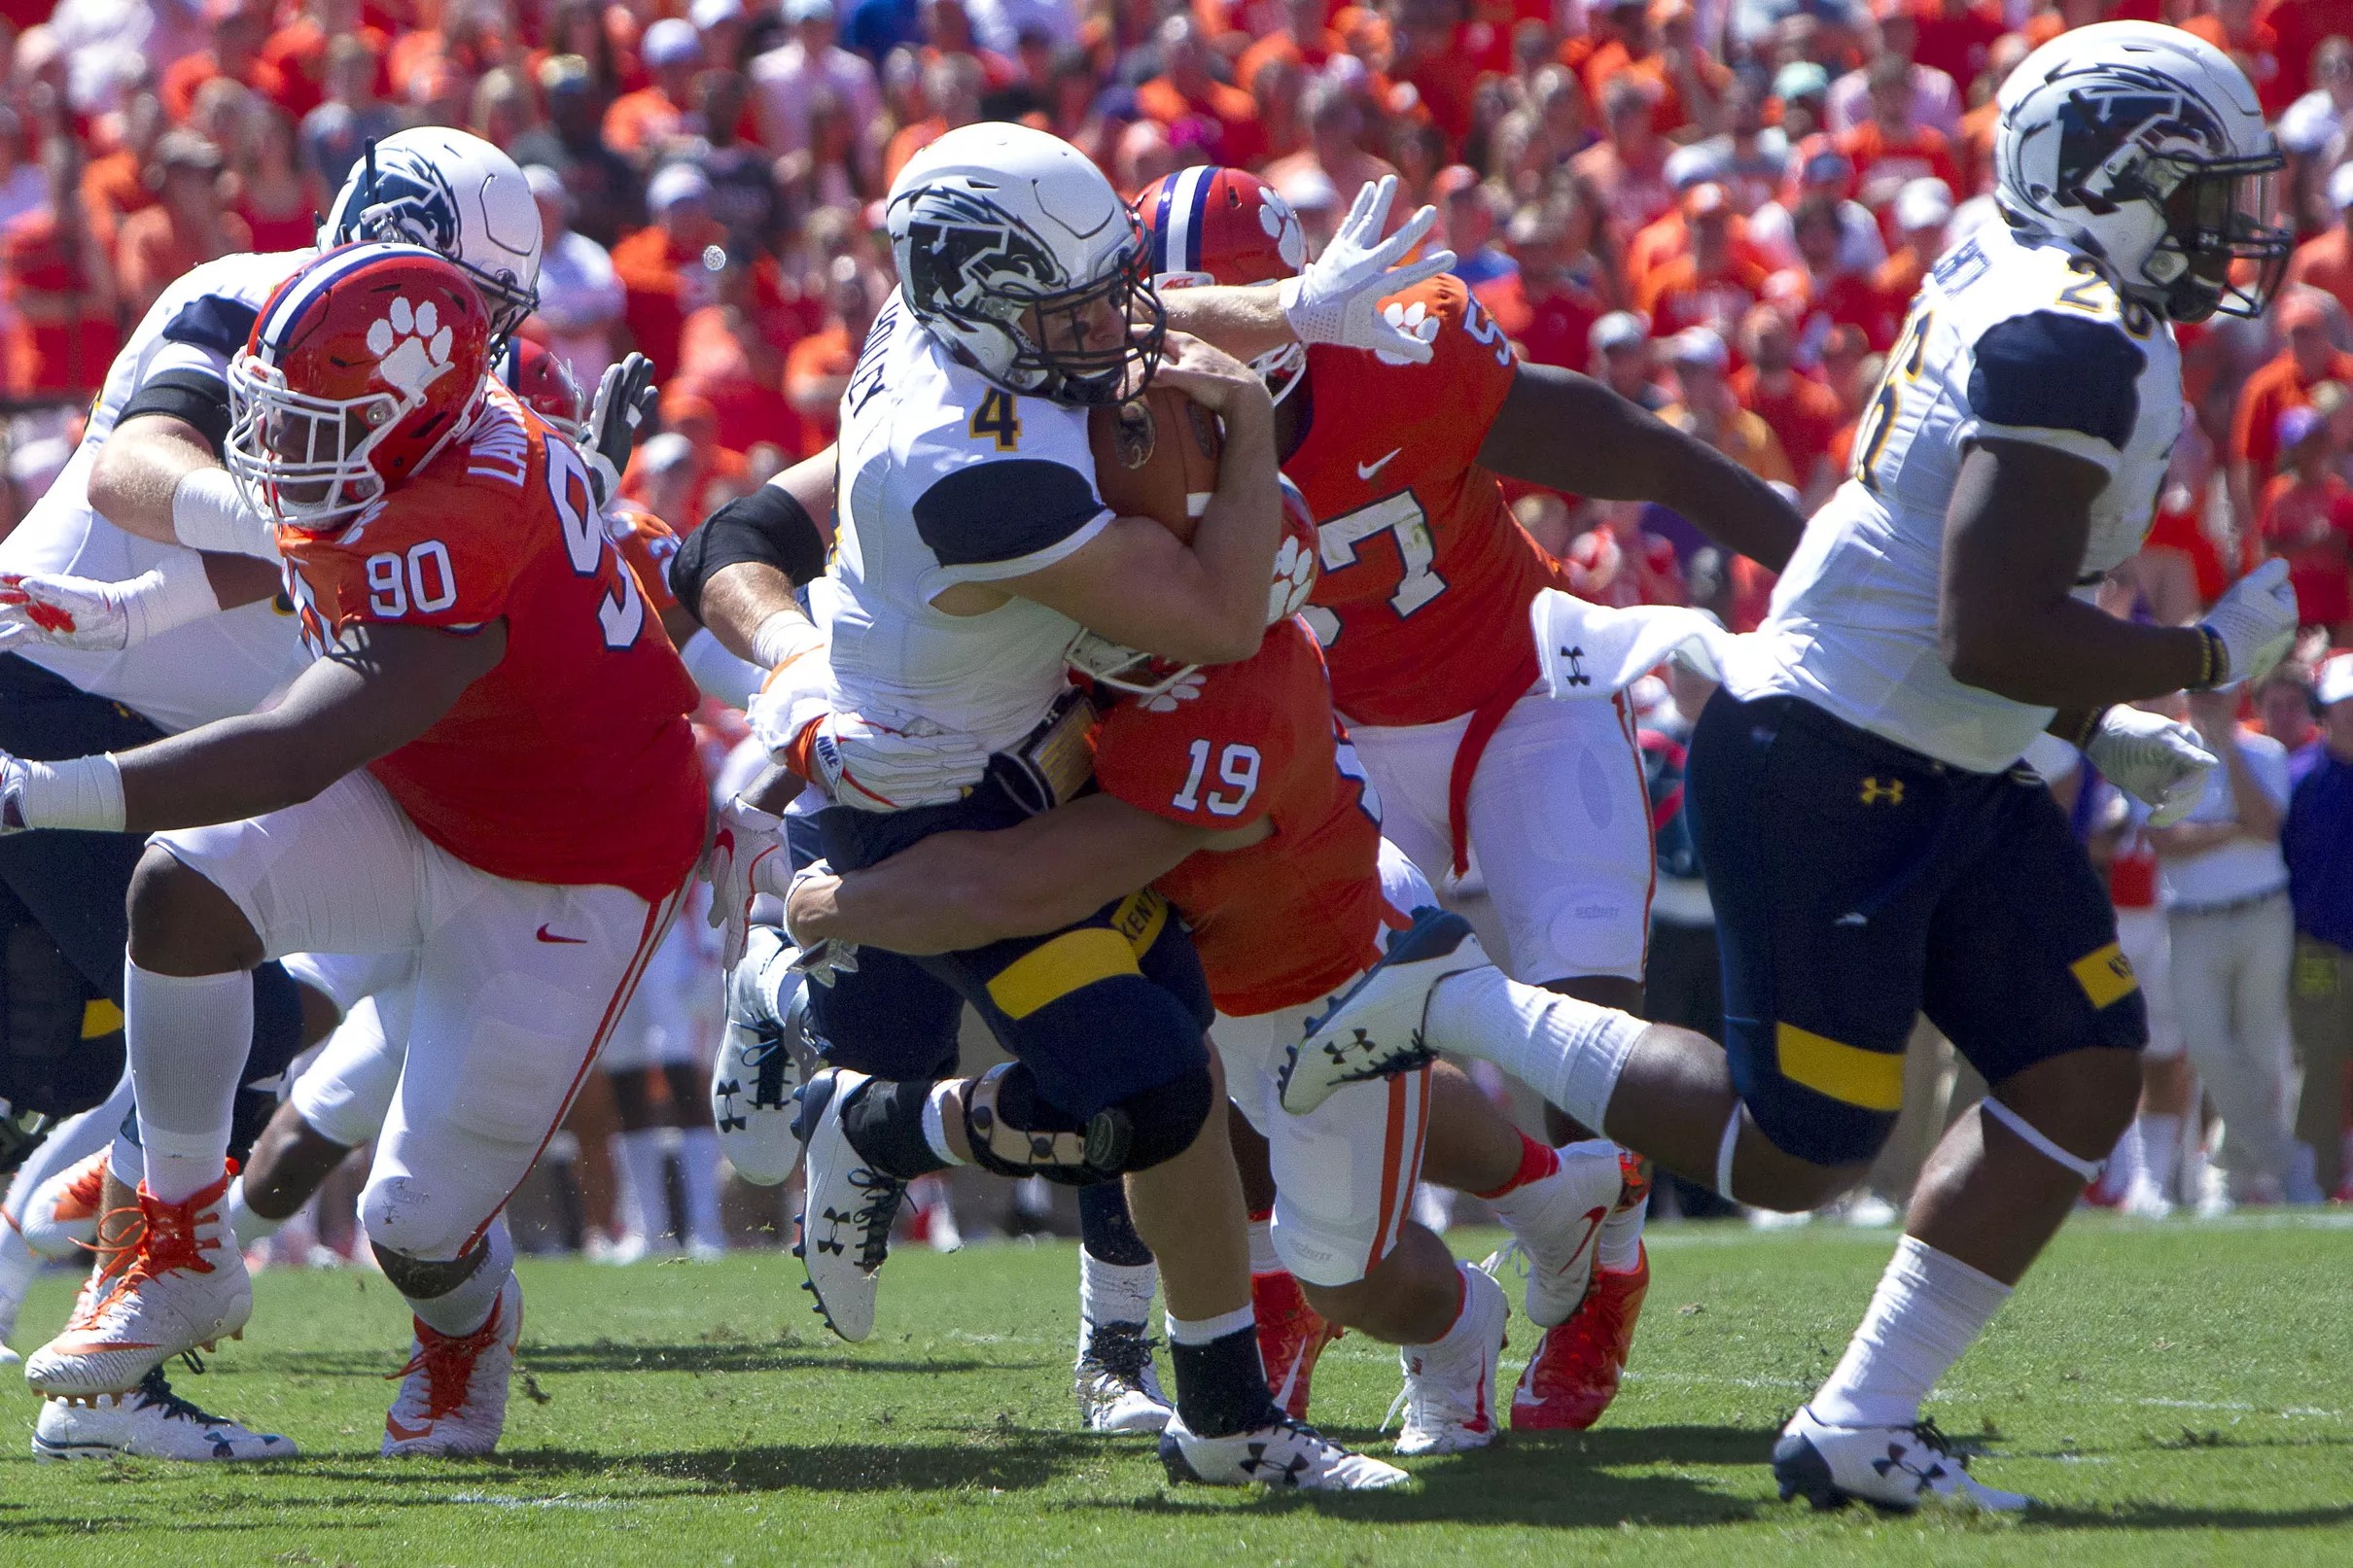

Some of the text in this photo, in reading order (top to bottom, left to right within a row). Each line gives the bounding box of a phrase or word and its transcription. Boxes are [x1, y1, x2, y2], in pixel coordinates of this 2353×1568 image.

[968, 384, 1023, 452] 4
[366, 539, 457, 619] 90
[817, 735, 841, 769] NIKE
[1171, 737, 1262, 818] 19
